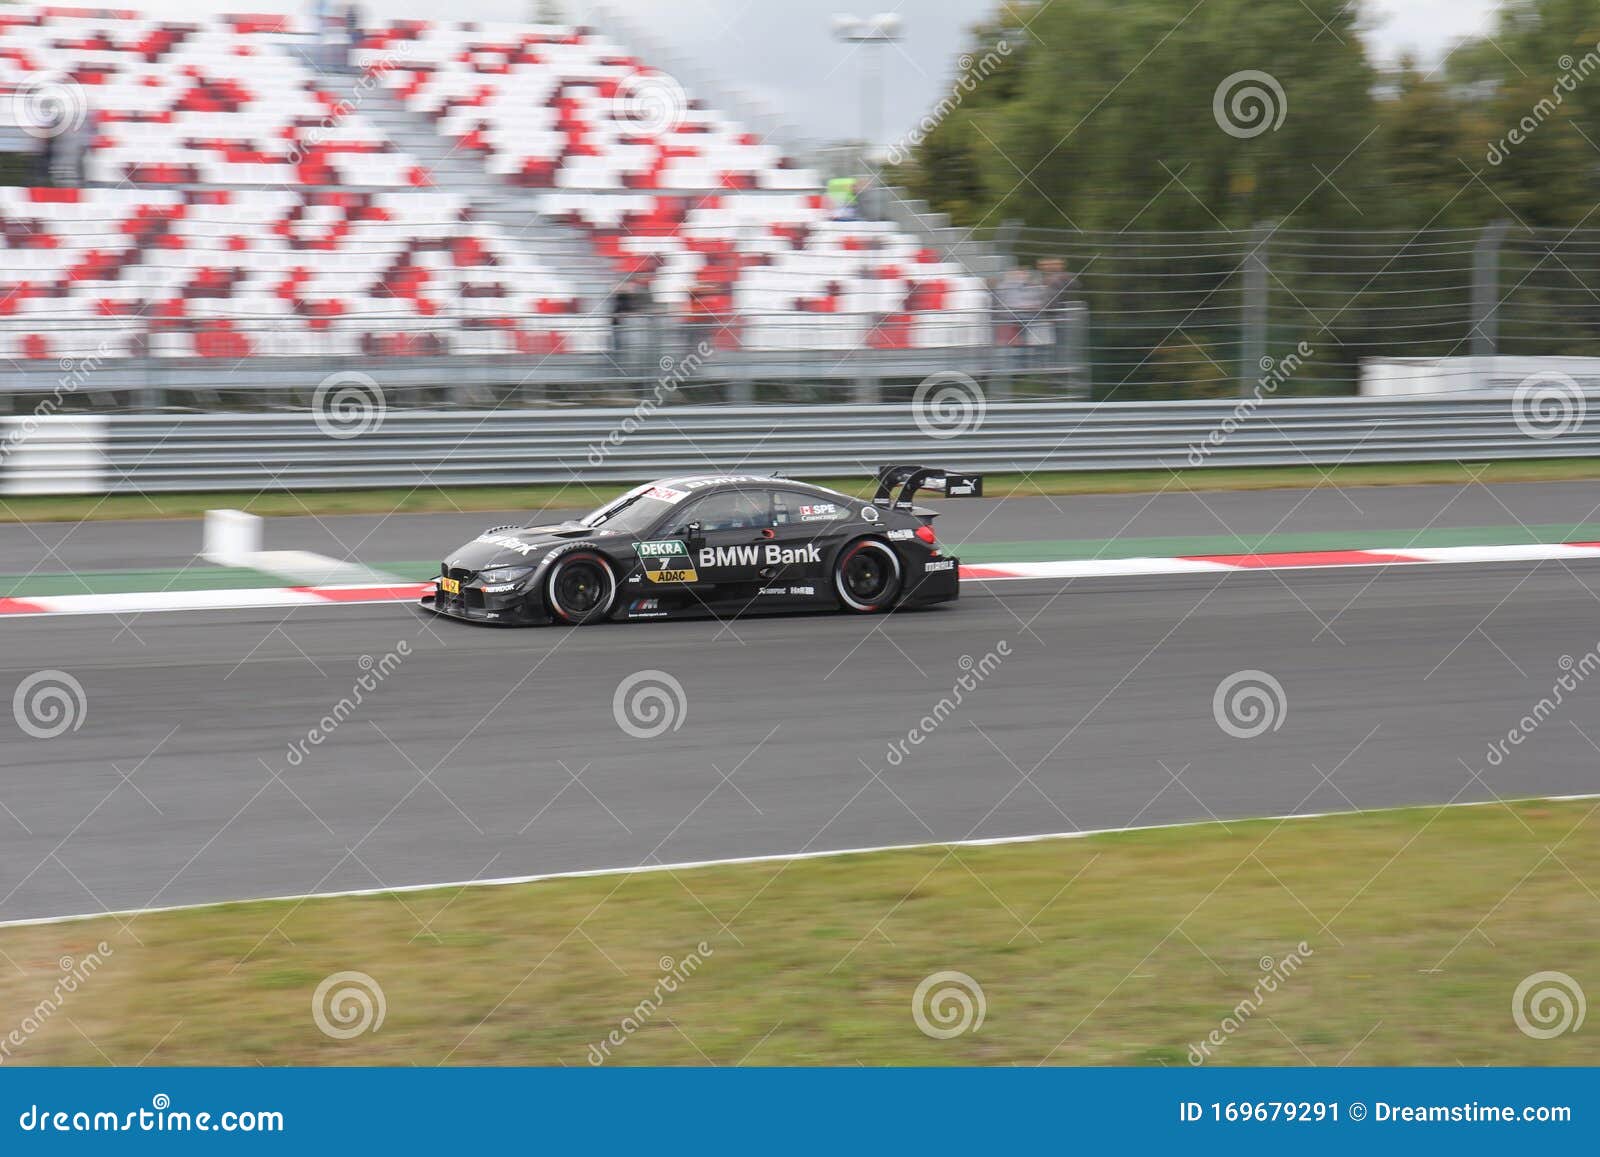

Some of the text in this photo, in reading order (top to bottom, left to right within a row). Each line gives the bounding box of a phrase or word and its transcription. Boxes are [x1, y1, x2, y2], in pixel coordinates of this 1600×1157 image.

[641, 543, 682, 555] DEKRA
[699, 543, 821, 568] BMW Bank
[659, 558, 670, 570] 7
[658, 571, 686, 581] ADAC
